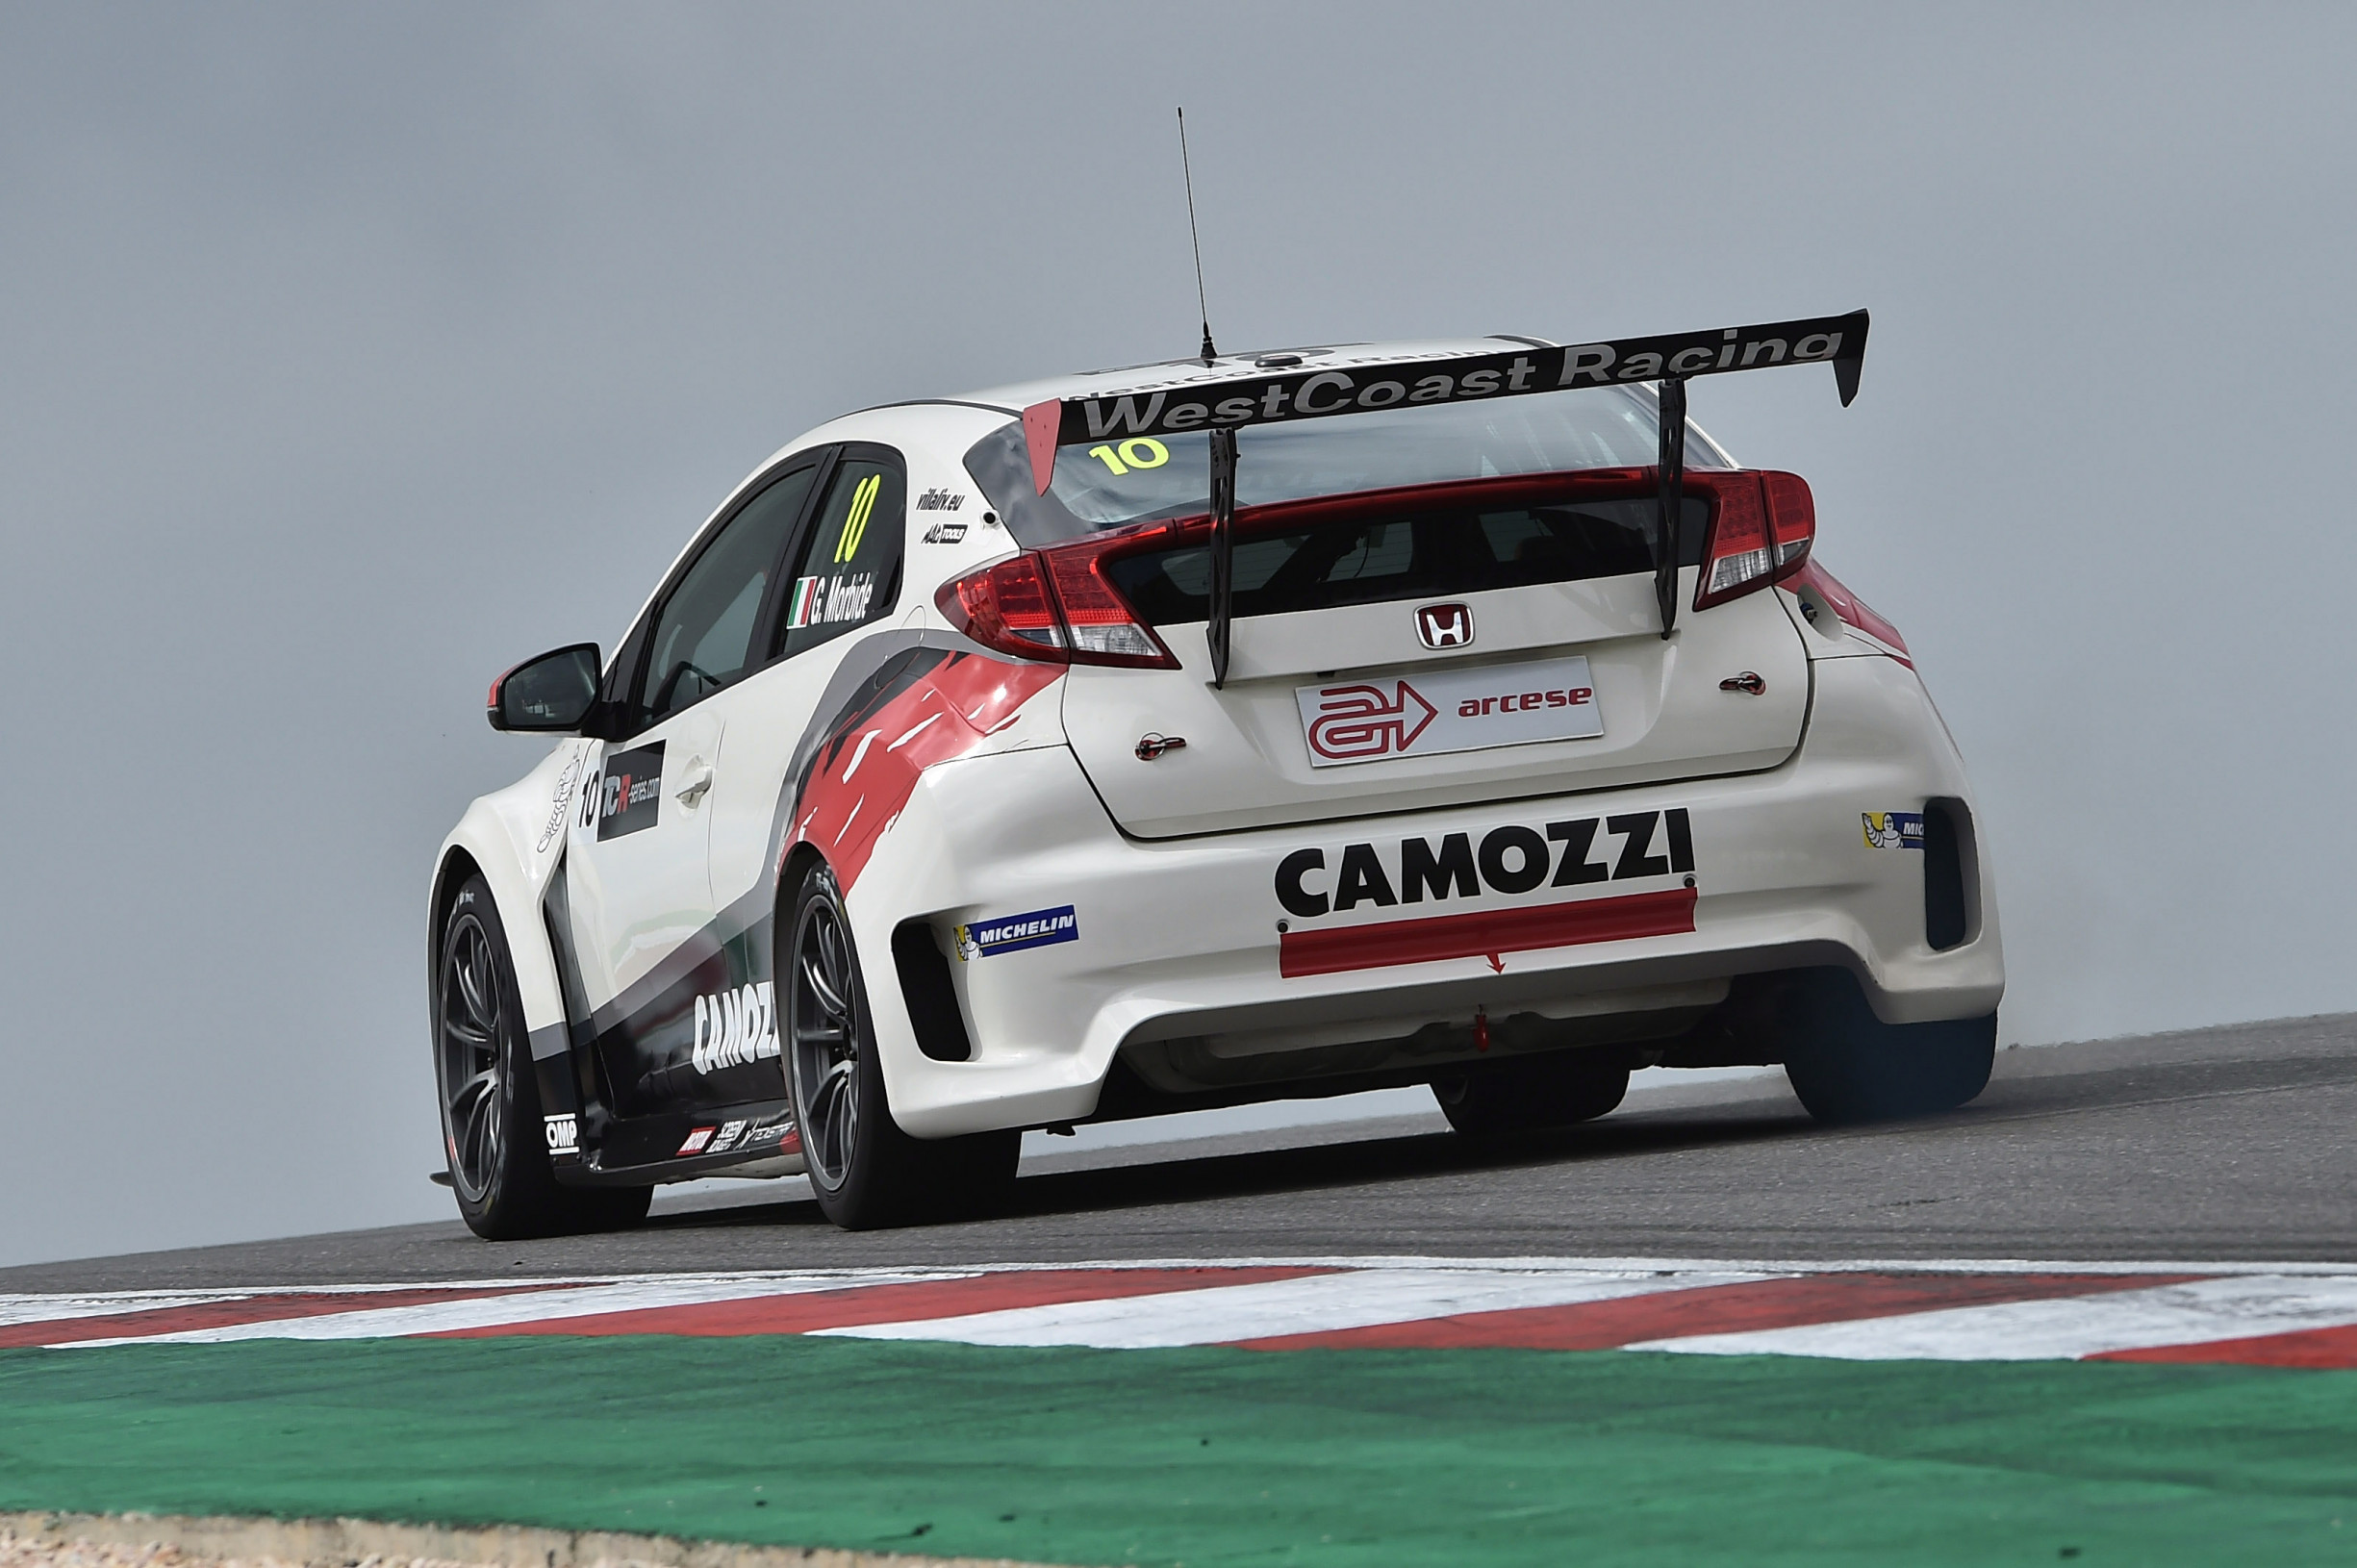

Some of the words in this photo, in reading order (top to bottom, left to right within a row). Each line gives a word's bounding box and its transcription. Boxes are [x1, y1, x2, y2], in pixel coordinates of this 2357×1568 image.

[1084, 357, 1536, 439] WestCoast
[1558, 329, 1842, 386] Racing
[1088, 437, 1170, 475] 10
[833, 473, 880, 564] 10
[810, 577, 827, 624] G.
[1458, 687, 1592, 718] arcese
[579, 770, 599, 828] 10
[1275, 807, 1696, 917] CAMOZZI
[980, 914, 1075, 944] MICHELIN
[545, 1121, 577, 1148] OMP
